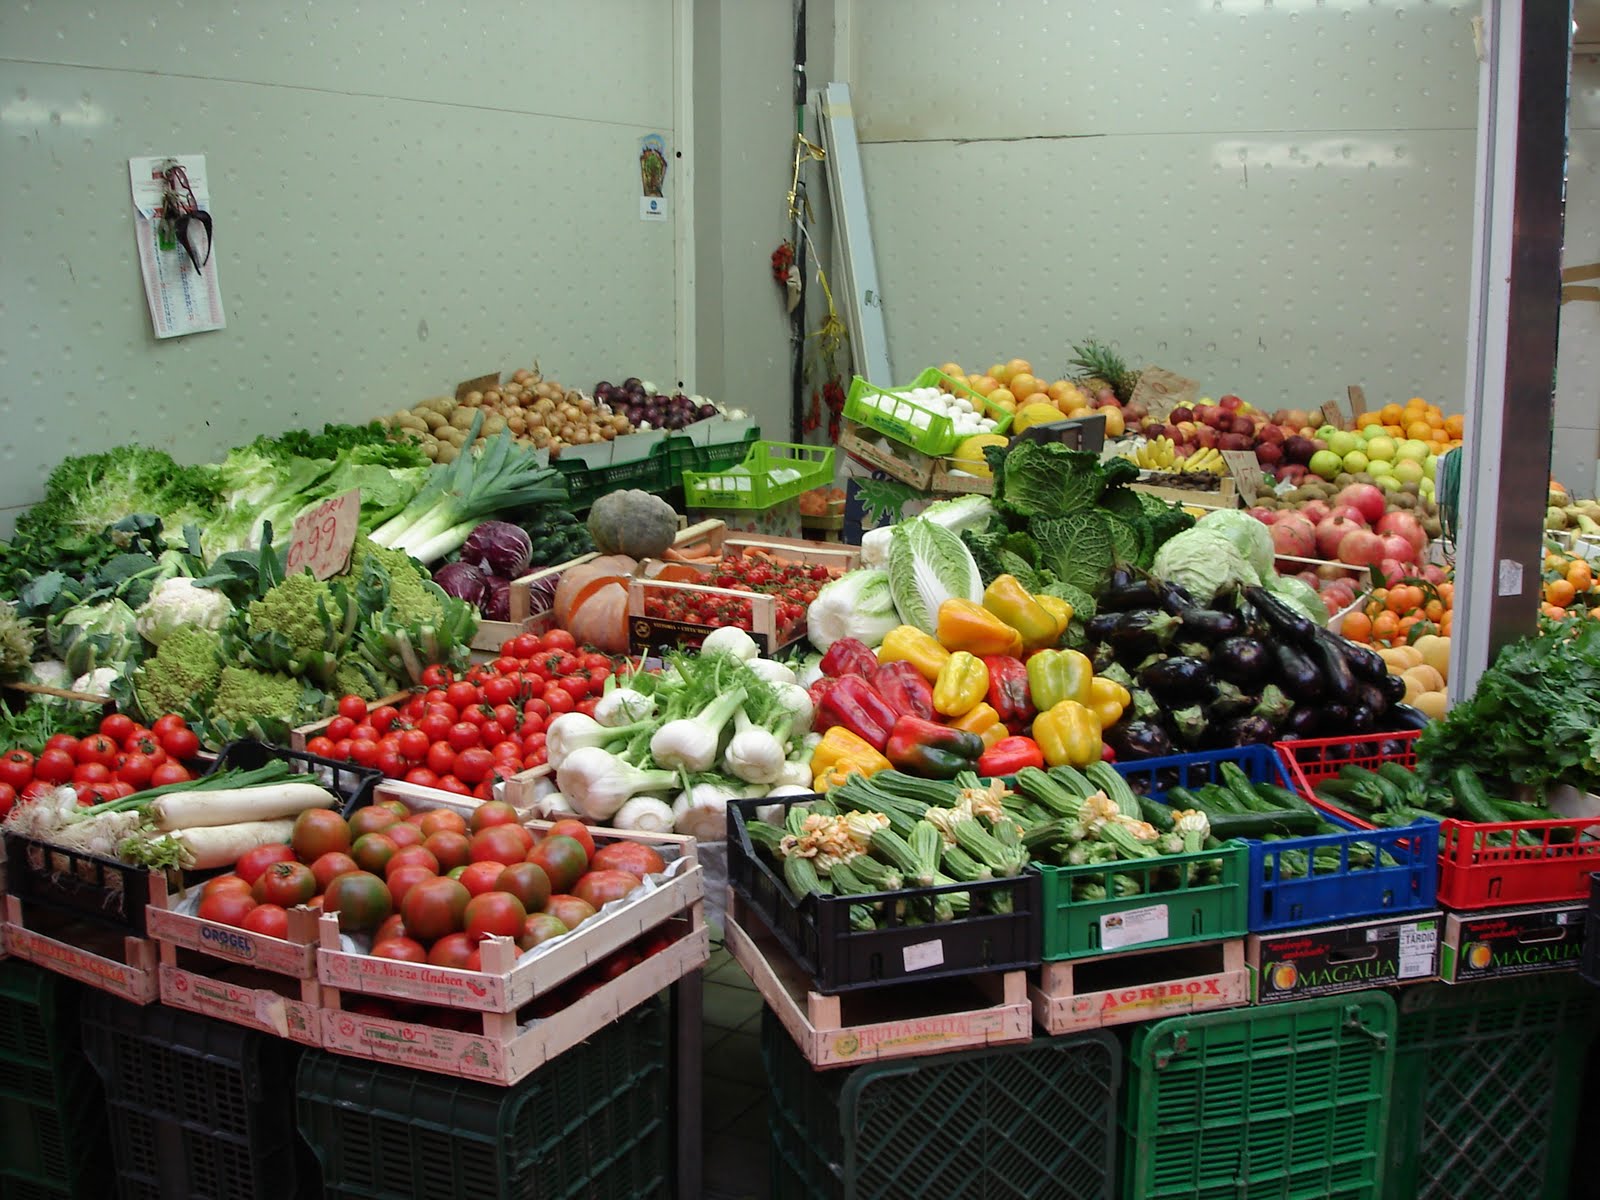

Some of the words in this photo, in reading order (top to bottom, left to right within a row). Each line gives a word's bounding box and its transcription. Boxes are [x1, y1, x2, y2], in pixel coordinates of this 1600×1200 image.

[202, 926, 251, 951] OROGEL
[1406, 932, 1435, 945] TARDIO
[1492, 943, 1581, 968] MAGALIA
[420, 969, 464, 987] Andrea
[1297, 959, 1396, 987] MAGALIA
[1101, 979, 1221, 1009] AGRIBOX
[858, 1023, 911, 1048] FRUTTA
[915, 1015, 968, 1034] SCELTA
